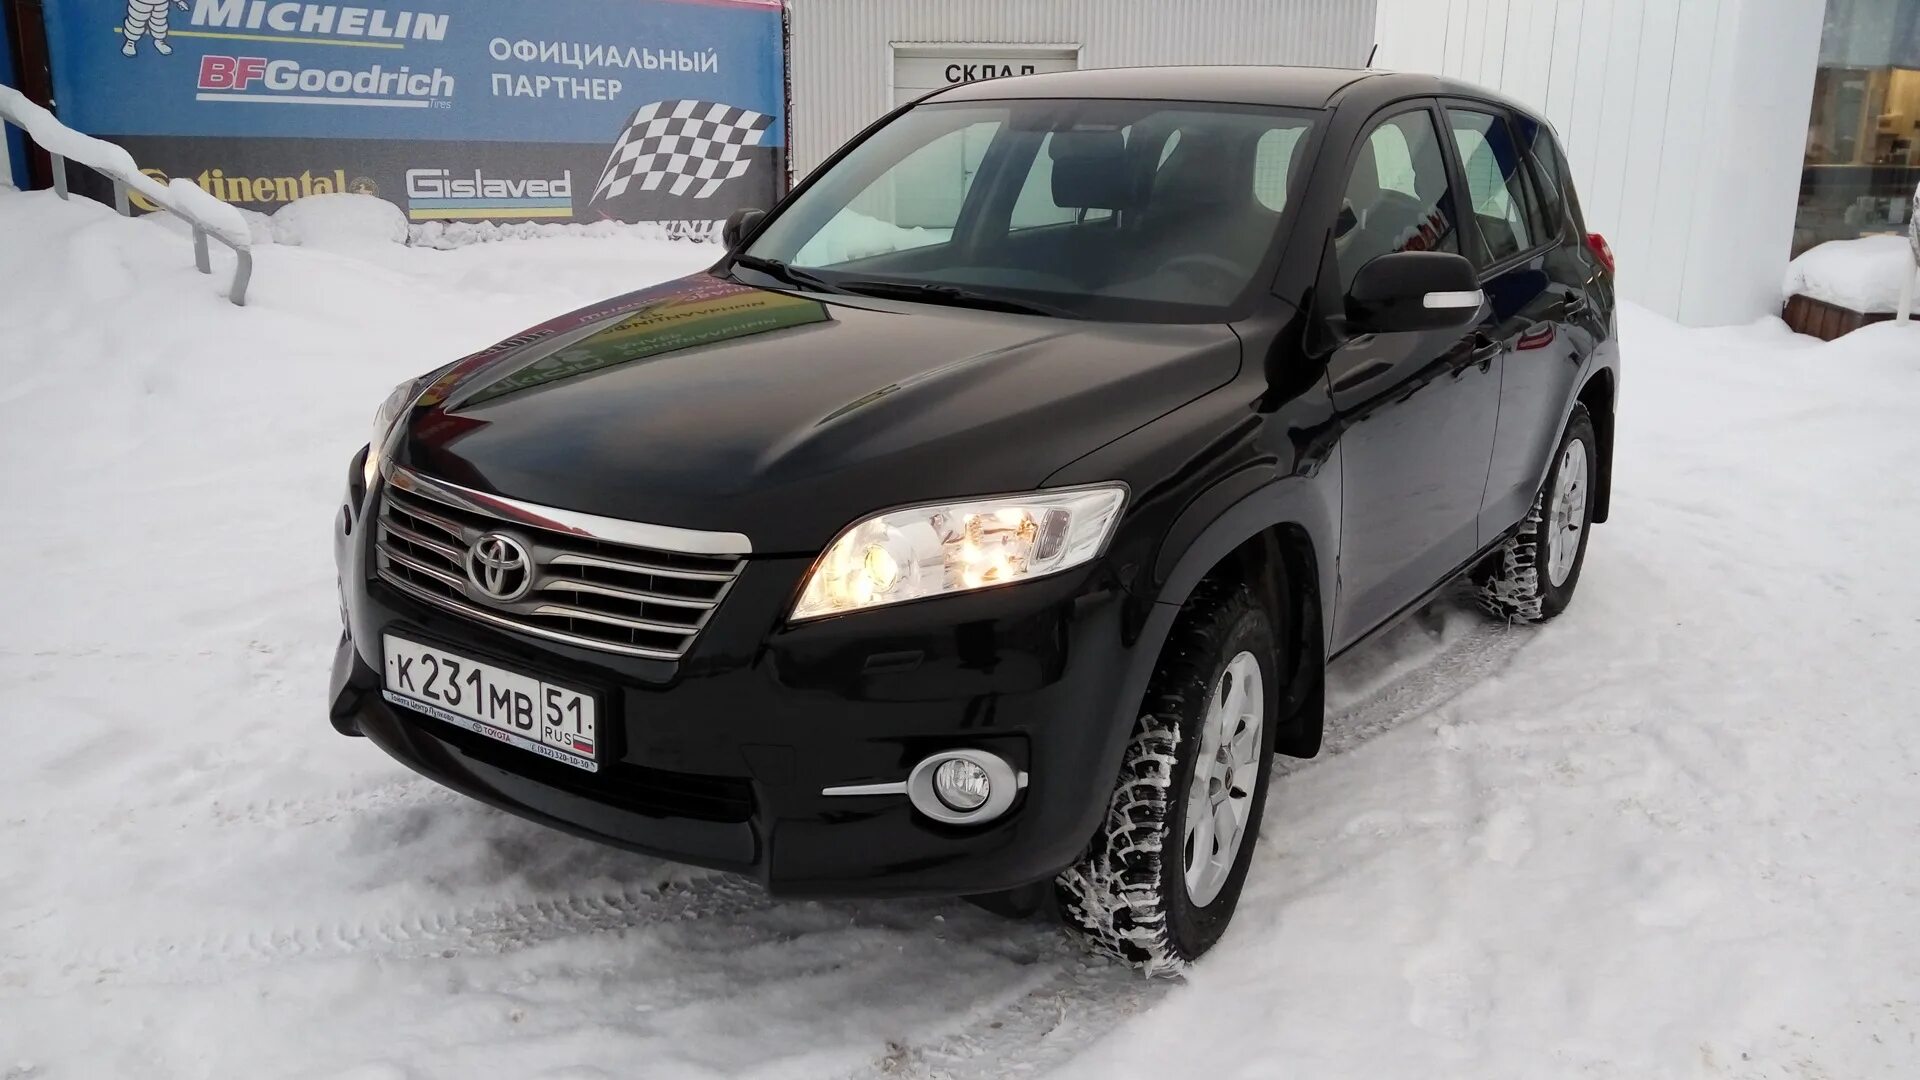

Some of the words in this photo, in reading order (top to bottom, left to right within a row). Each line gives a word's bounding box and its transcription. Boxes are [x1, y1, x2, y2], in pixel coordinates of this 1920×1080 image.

[191, 0, 450, 41] MICHELIN
[488, 37, 718, 73] ОФИЦИАЛЬНЫЙ
[197, 54, 455, 97] BFGoodrich
[491, 73, 623, 101] ПАРТНЕР
[429, 98, 451, 109] Tires
[405, 168, 572, 198] Gislaved
[546, 688, 582, 734] 51
[483, 726, 511, 742] TOYOTA
[545, 726, 572, 746] RUS
